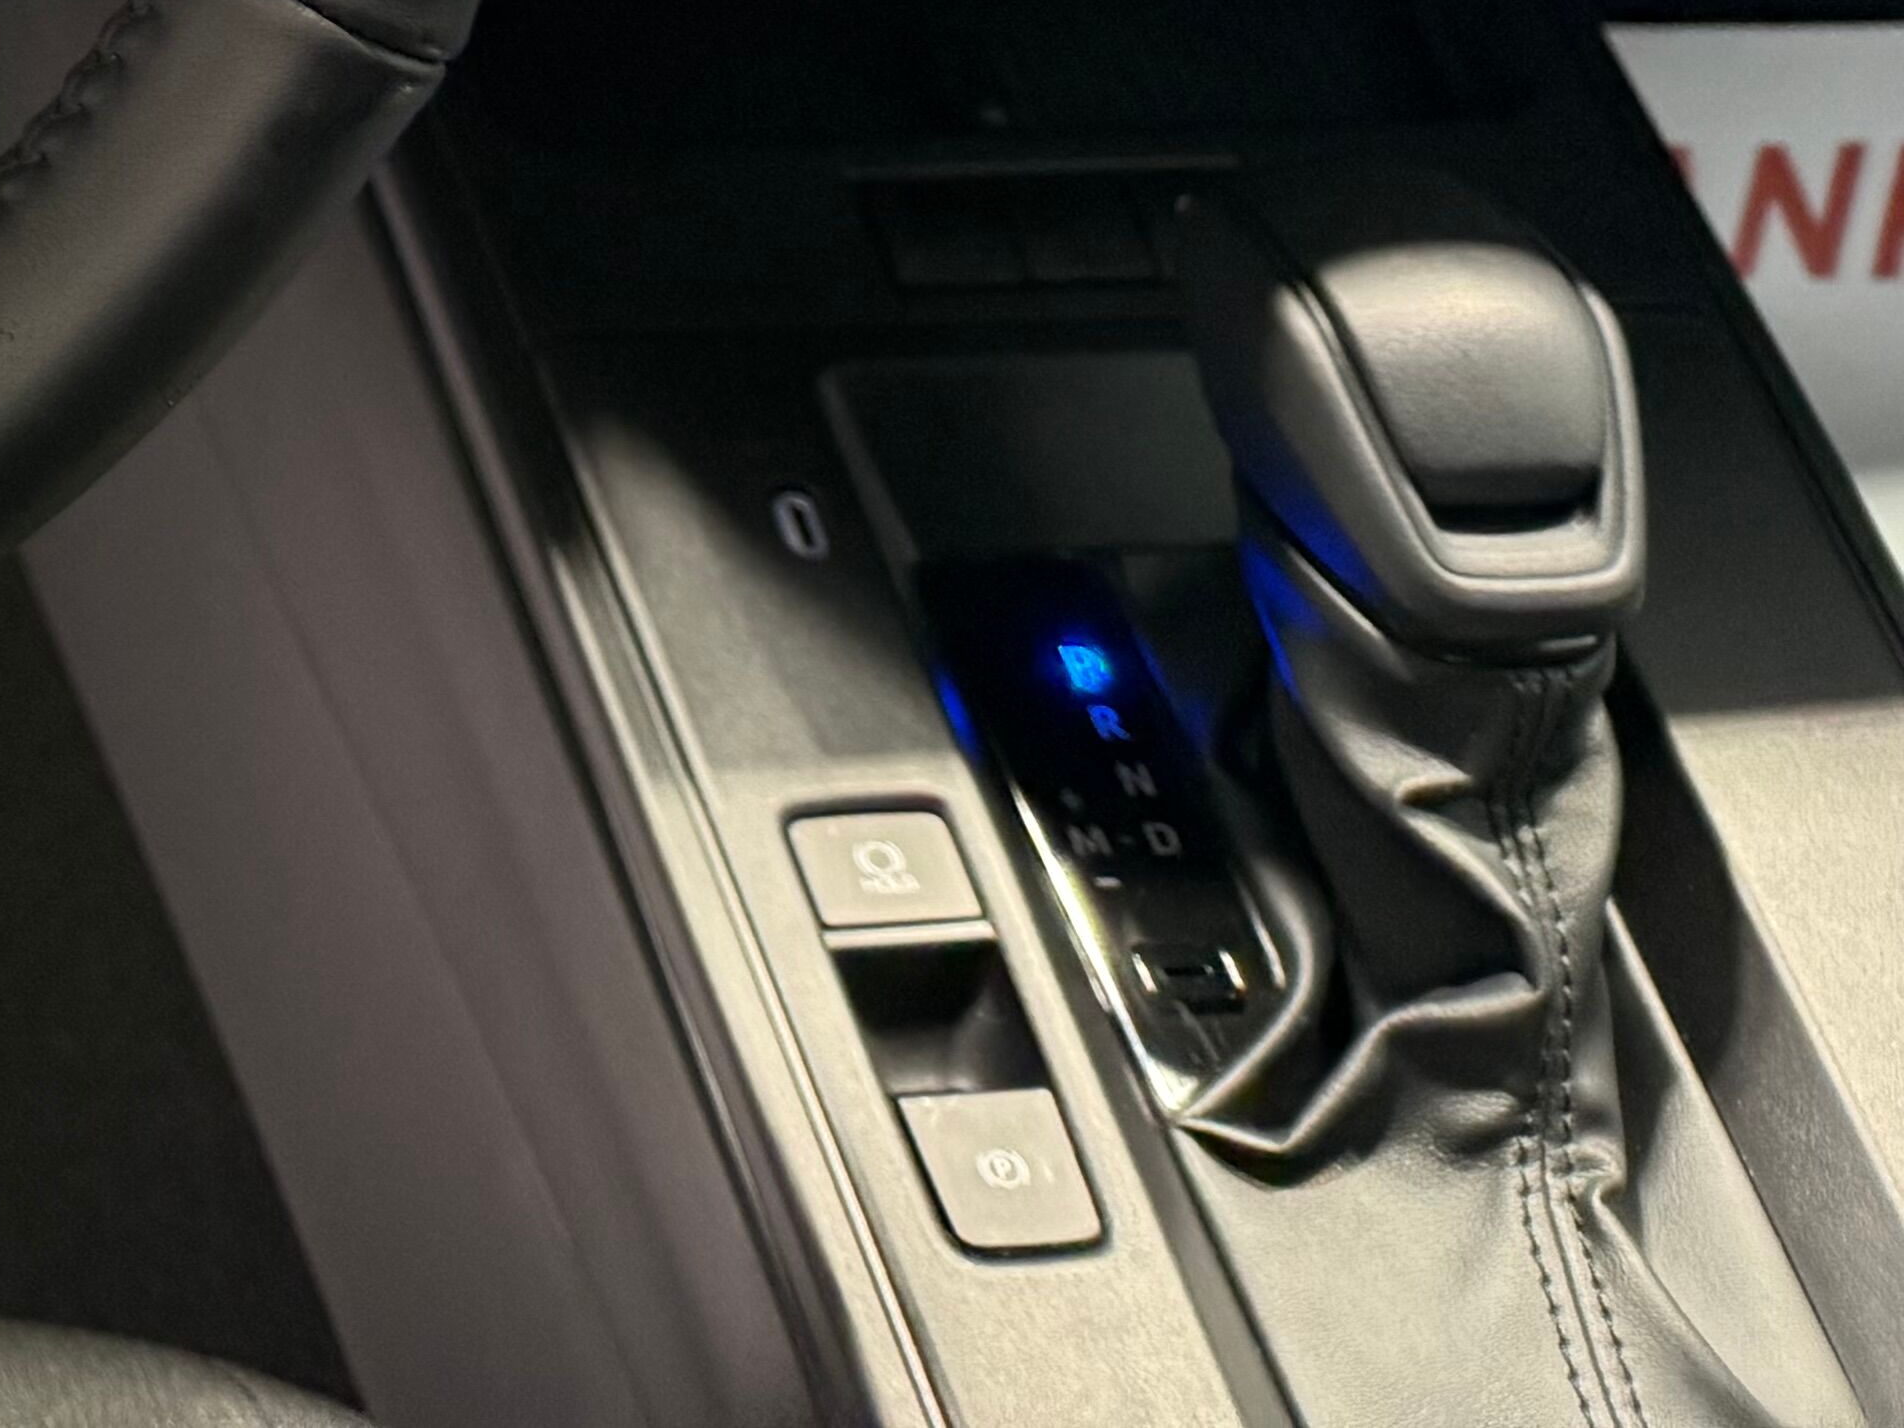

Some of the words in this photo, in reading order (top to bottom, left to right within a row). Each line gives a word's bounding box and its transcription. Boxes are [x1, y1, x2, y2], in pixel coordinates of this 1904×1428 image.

[1087, 704, 1130, 741] R
[1115, 760, 1157, 796] N
[1067, 824, 1113, 856] M
[1142, 821, 1182, 857] D
